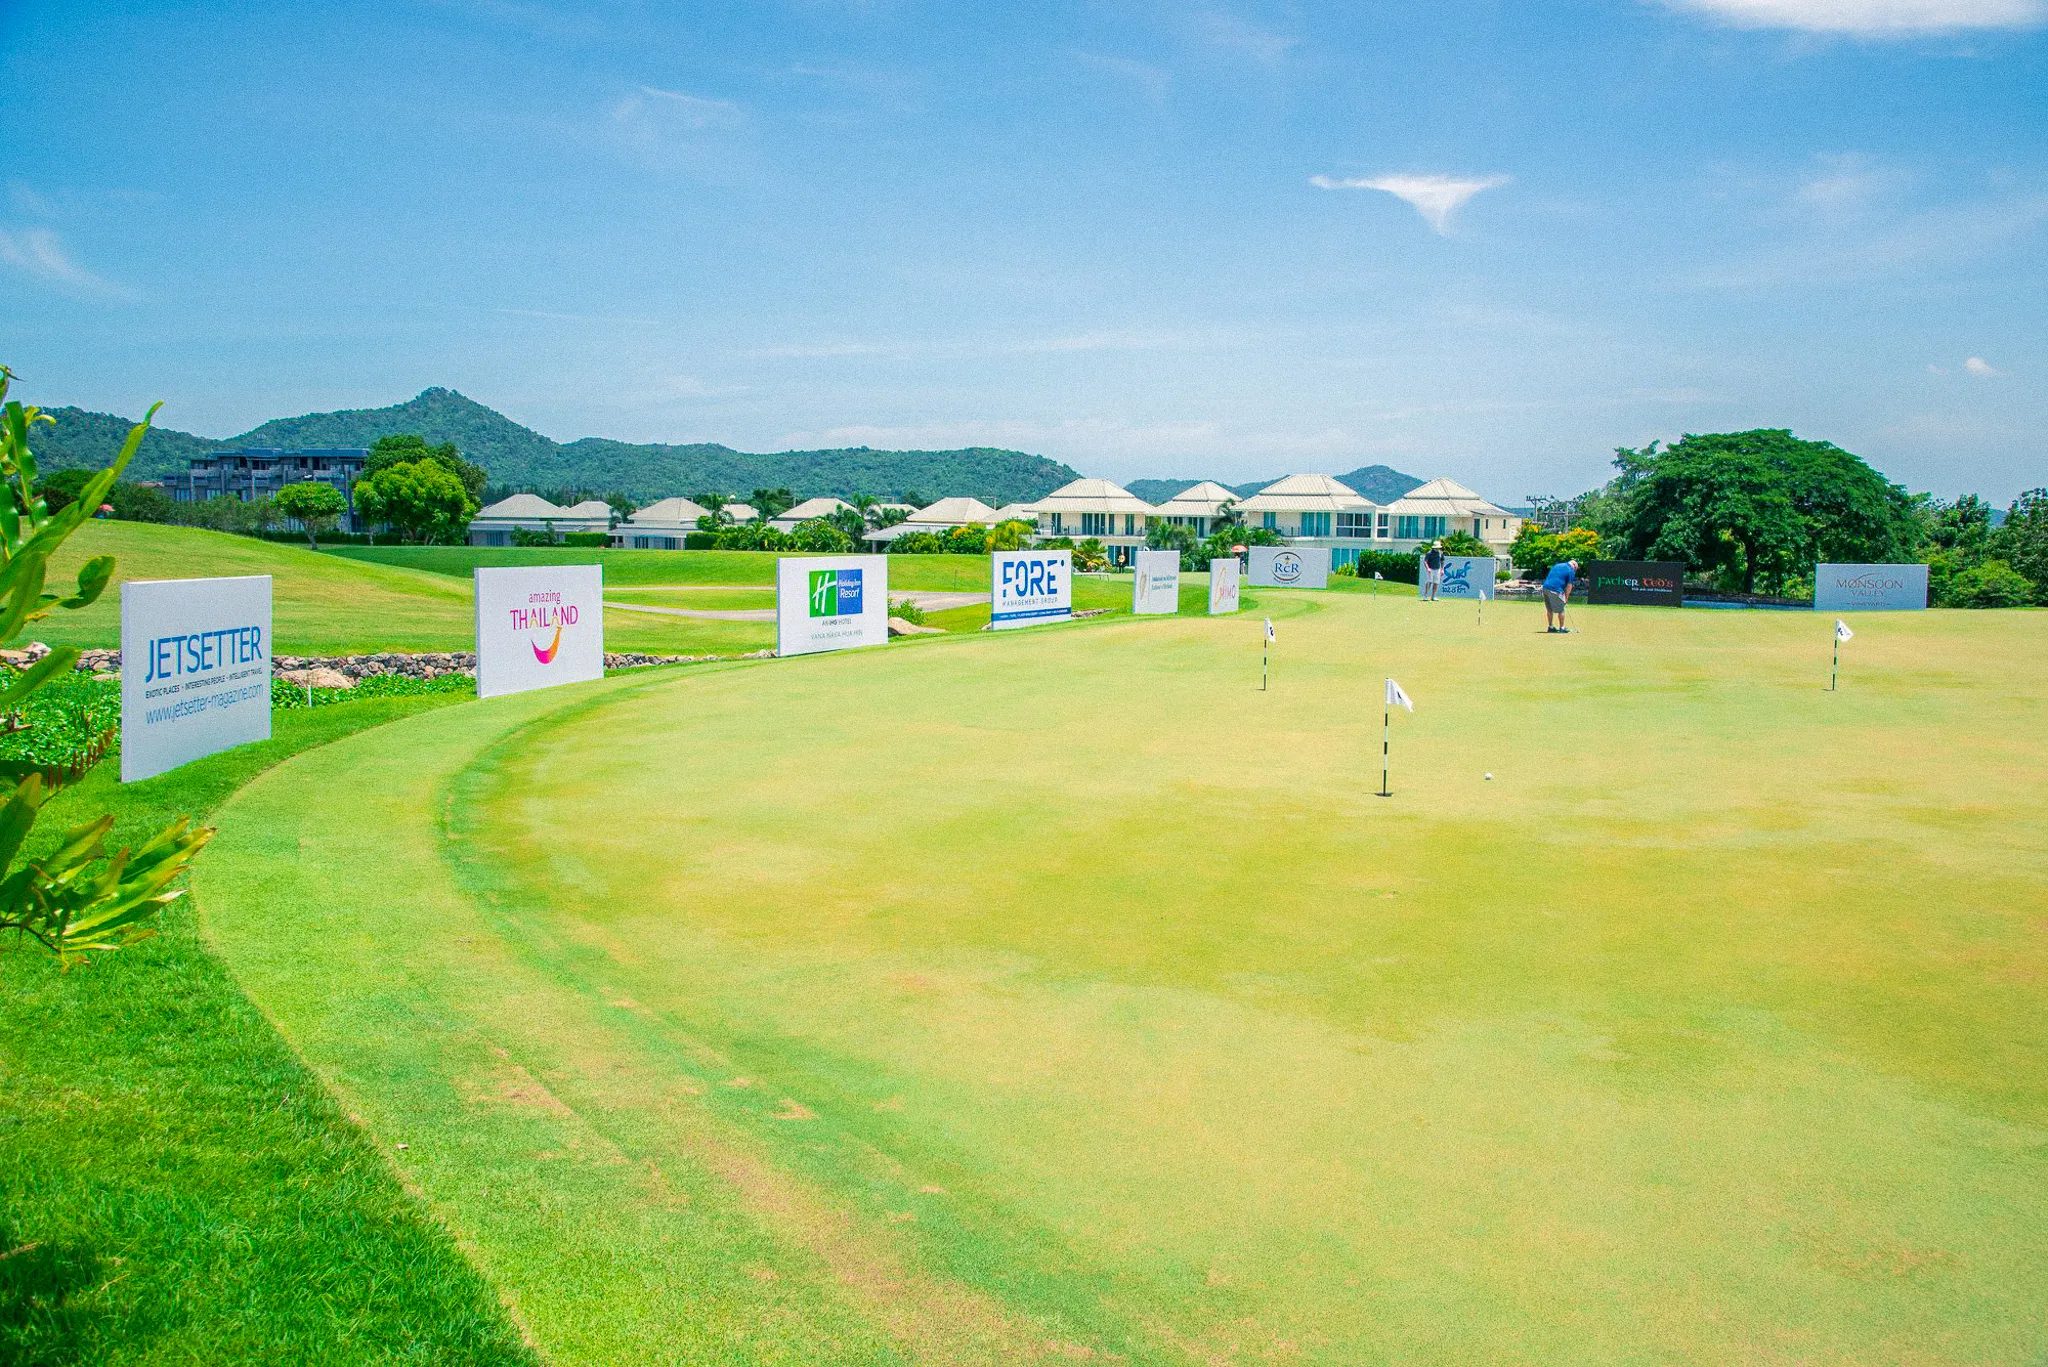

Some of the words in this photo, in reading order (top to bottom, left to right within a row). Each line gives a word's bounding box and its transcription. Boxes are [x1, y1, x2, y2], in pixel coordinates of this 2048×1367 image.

[1003, 560, 1058, 598] FORE
[1836, 579, 1904, 590] MONSOON
[529, 590, 561, 604] amazing
[840, 588, 860, 598] Resort
[1002, 598, 1038, 606] MANAGEMENT
[510, 605, 578, 630] THAILAND
[145, 626, 262, 683] JETSETTER
[145, 688, 162, 699] EXOTIC
[163, 684, 180, 695] PLACES
[185, 677, 210, 690] INTERESTING
[210, 675, 226, 685] PEOPLE
[145, 684, 263, 724] www.jetsetter-magazine.com
